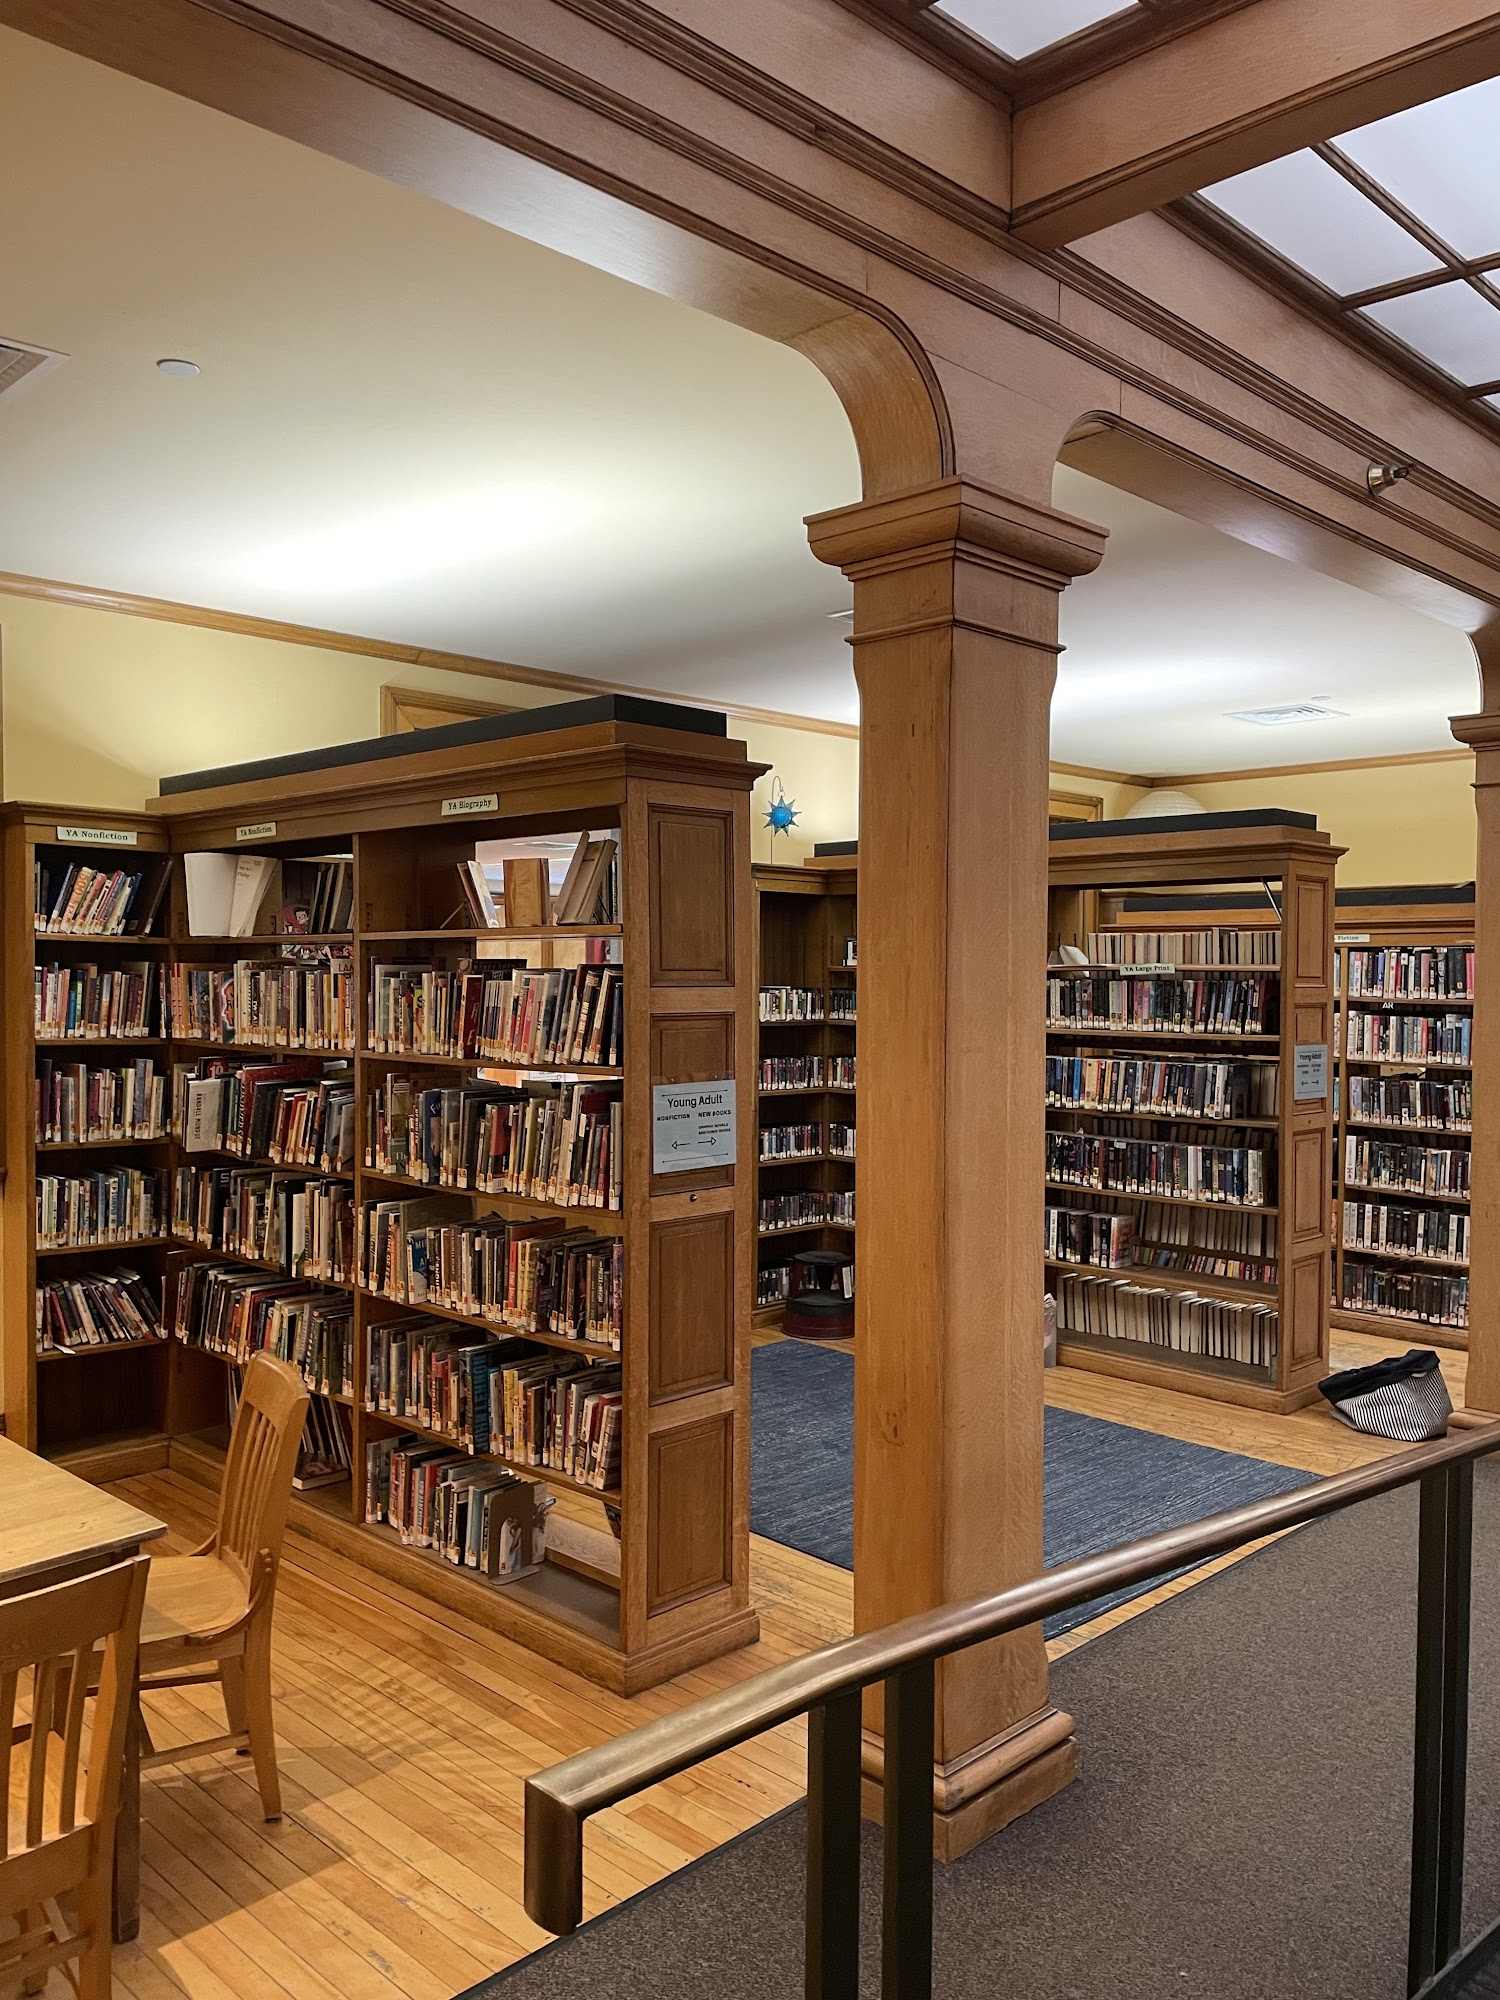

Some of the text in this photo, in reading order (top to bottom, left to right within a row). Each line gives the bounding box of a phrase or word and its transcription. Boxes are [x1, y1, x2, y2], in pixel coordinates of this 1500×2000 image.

[448, 799, 492, 810] YA Biography
[81, 831, 128, 840] Nonfiction
[248, 826, 272, 835] Nonfiction
[668, 1094, 722, 1108] Young Adult
